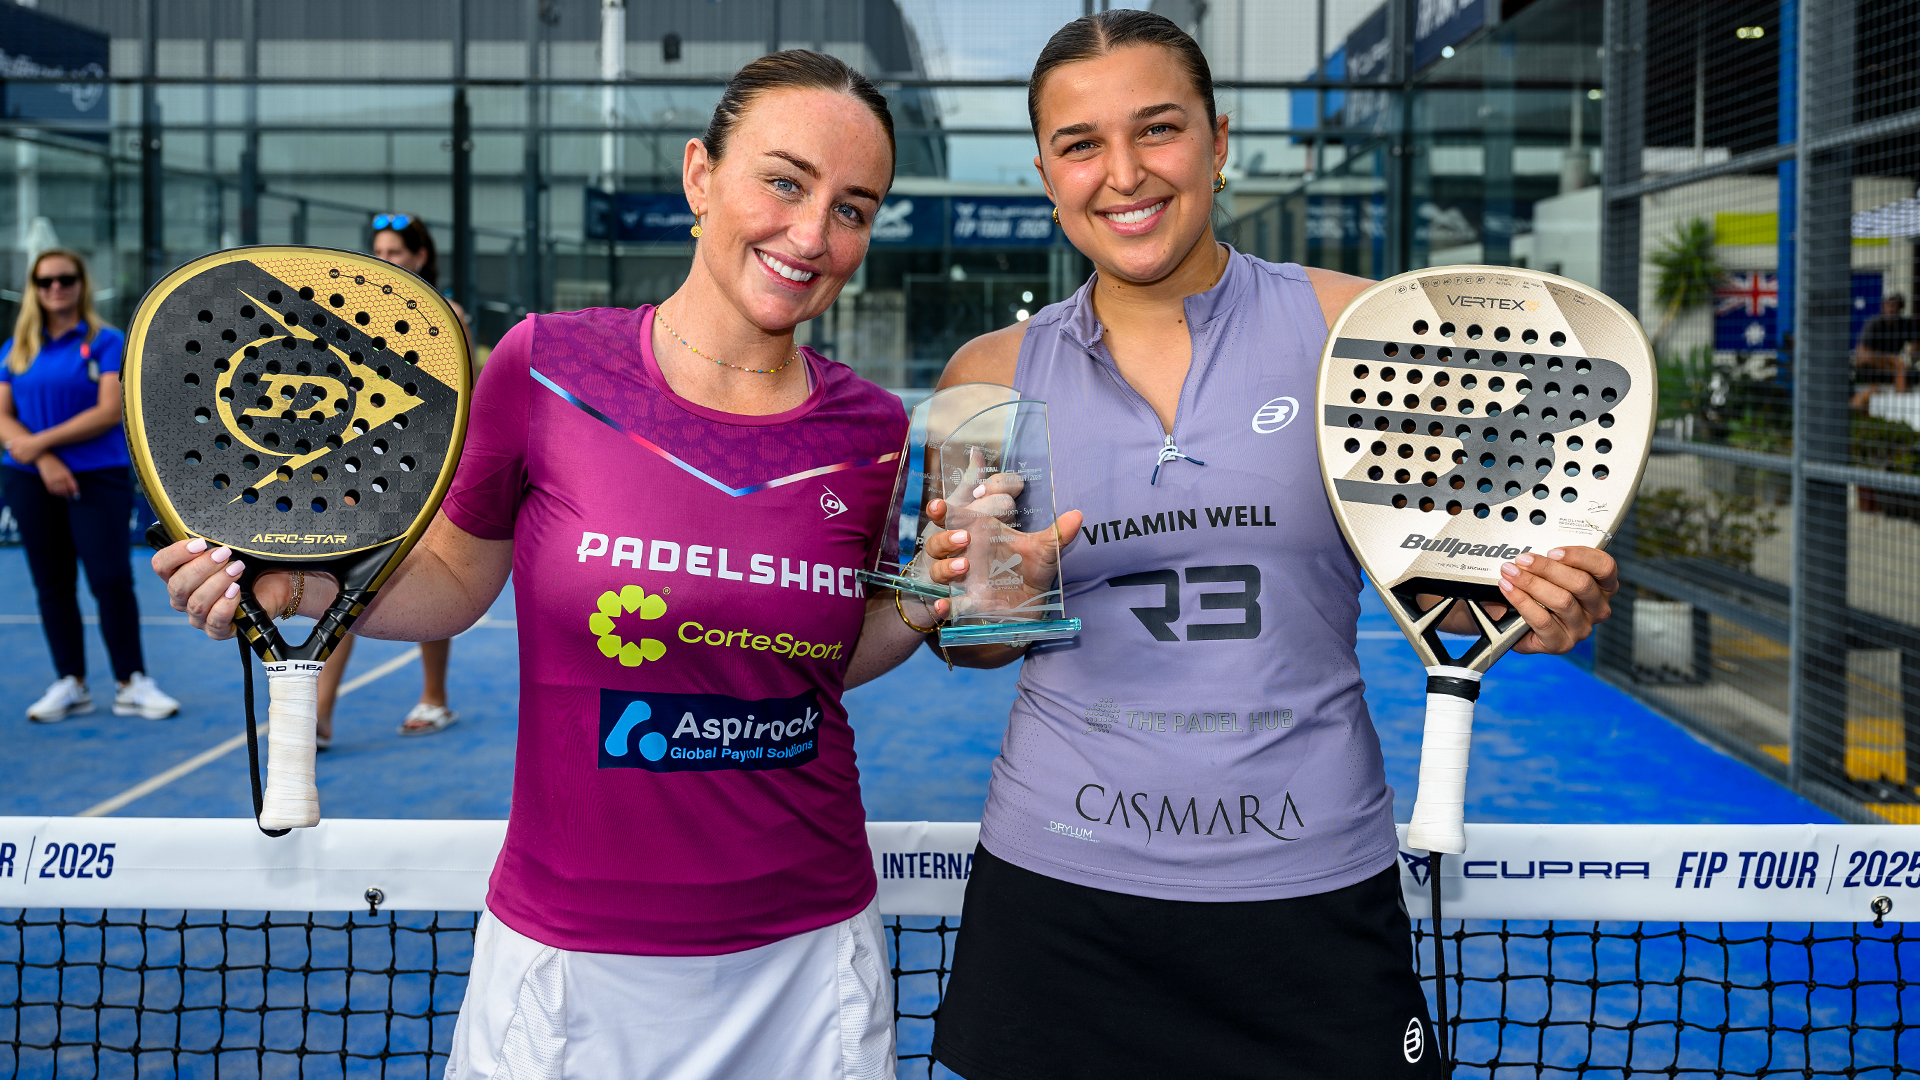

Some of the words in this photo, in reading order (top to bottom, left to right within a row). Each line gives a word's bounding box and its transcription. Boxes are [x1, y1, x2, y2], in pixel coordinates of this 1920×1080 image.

[1447, 295, 1525, 311] VERTEX
[1024, 507, 1043, 515] Sydney
[1082, 509, 1198, 546] VITAMIN
[1205, 505, 1277, 527] WELL
[250, 533, 348, 544] AERO-STAR
[989, 535, 1016, 543] WINNER
[986, 575, 1024, 587] padel
[672, 706, 819, 746] Aspirock
[1125, 710, 1167, 732] THE
[1172, 712, 1243, 733] PADEL
[1250, 708, 1294, 731] HUB
[670, 746, 717, 759] Global
[721, 746, 764, 762] Payroll
[766, 740, 813, 758] Solutions
[1075, 783, 1305, 848] CASMARA
[1050, 820, 1093, 839] DRYLUM
[39, 842, 116, 878] 2025
[1463, 860, 1650, 879] CUPRA
[1675, 851, 1728, 889] FIP
[1738, 850, 1819, 889] TOUR
[1843, 850, 1920, 888] 2025
